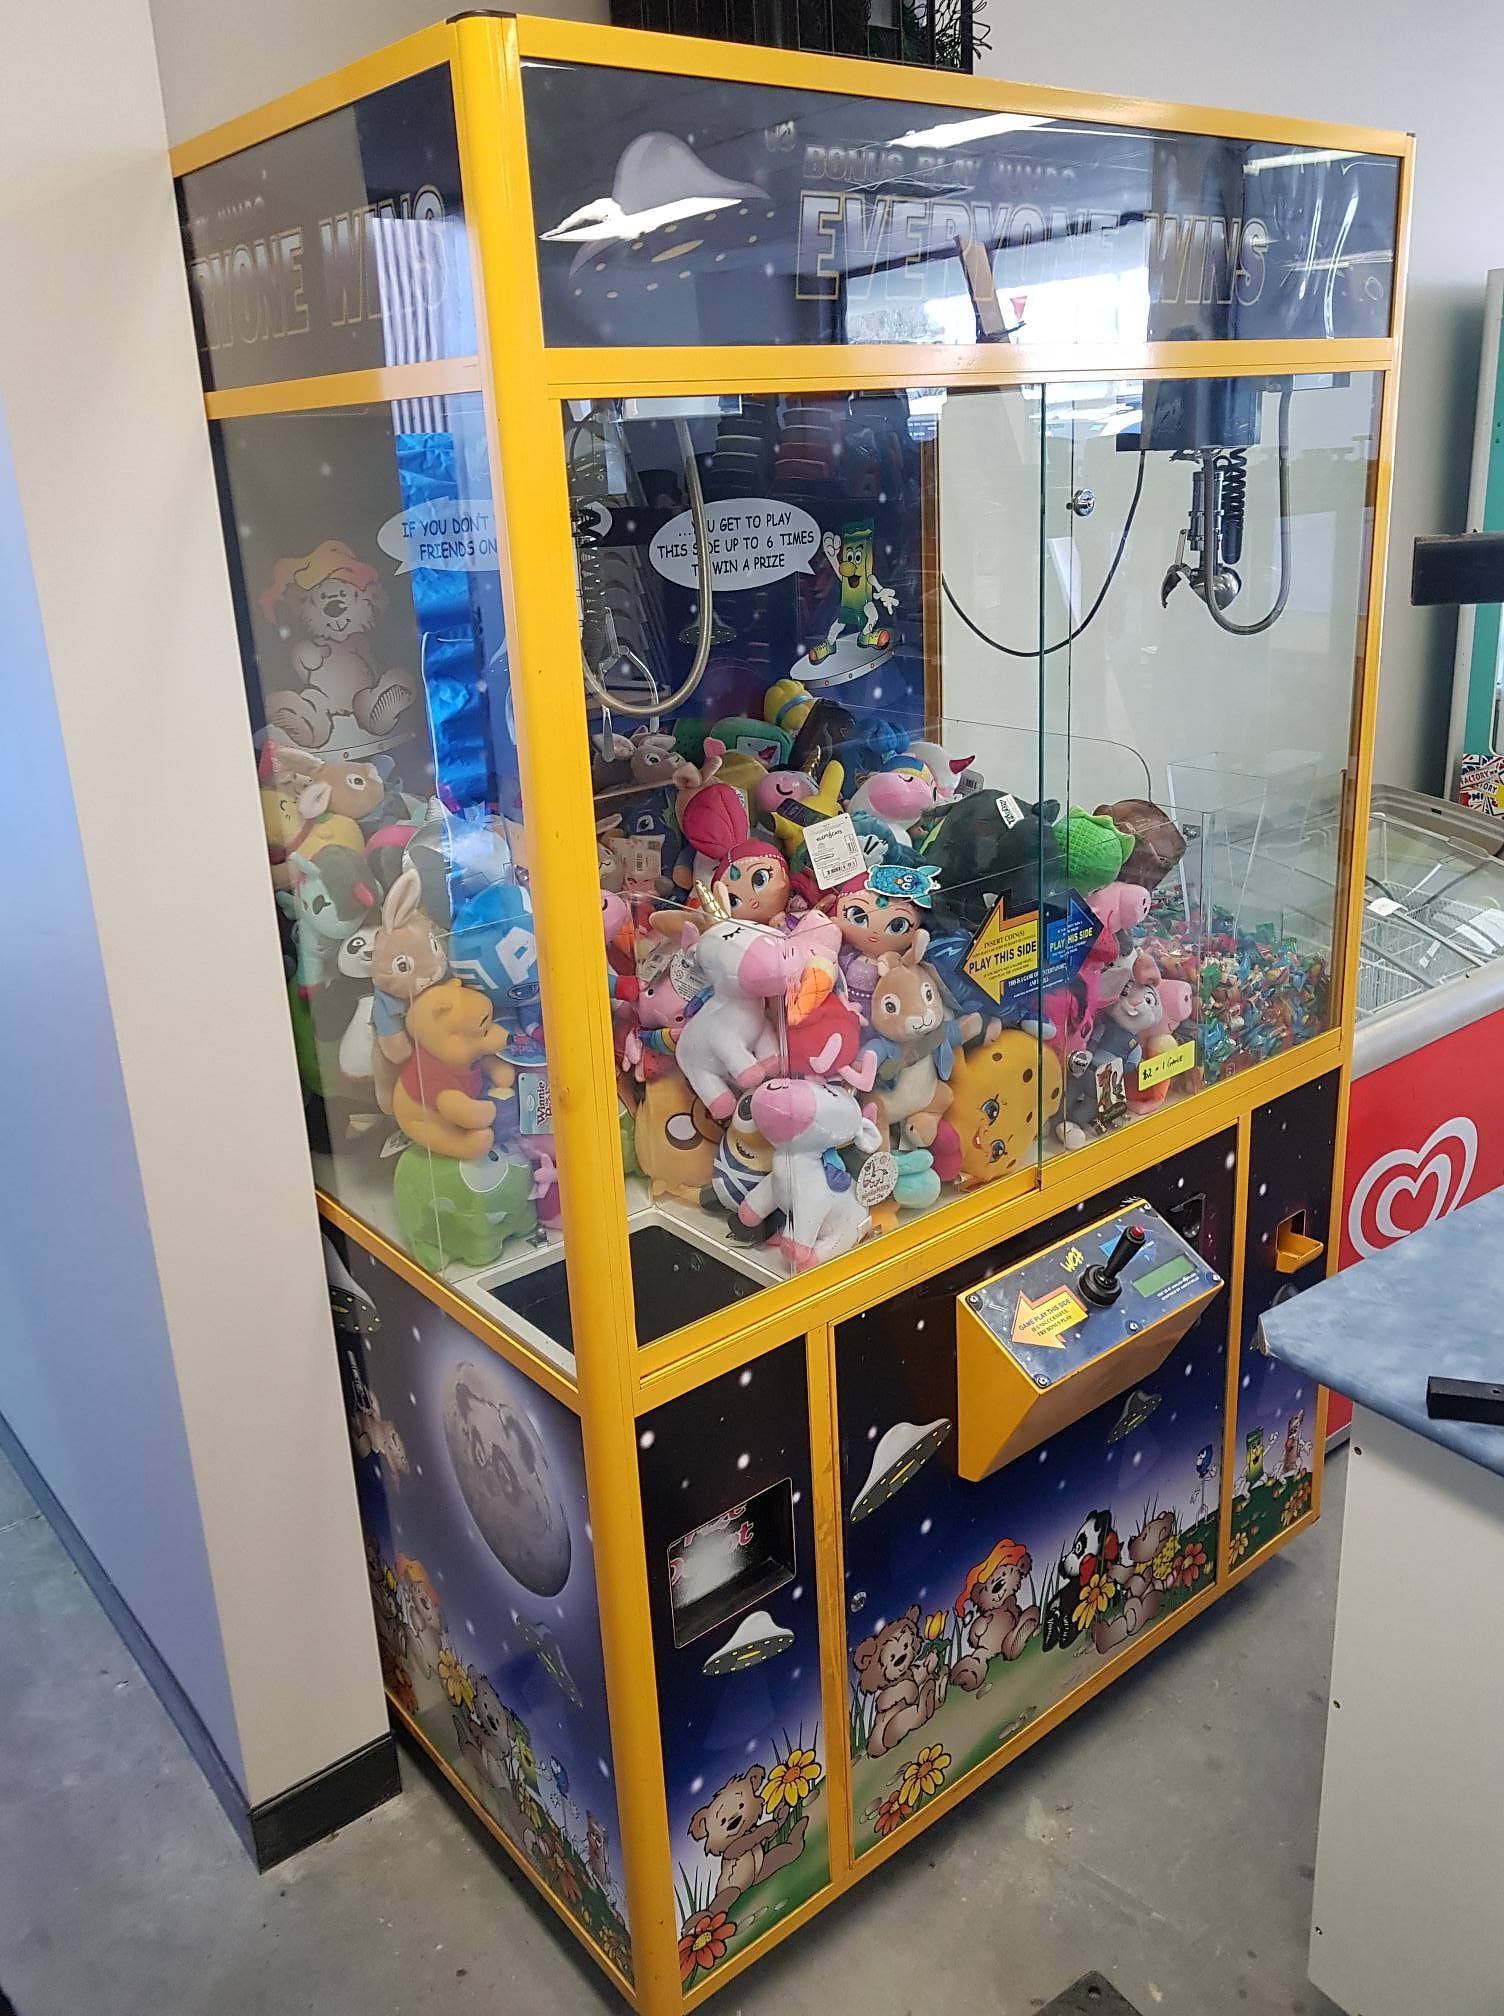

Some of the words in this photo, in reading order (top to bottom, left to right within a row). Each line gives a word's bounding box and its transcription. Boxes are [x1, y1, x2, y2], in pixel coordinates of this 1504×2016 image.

[803, 144, 905, 182] BONUS
[795, 189, 1122, 302] EVERYONE
[1144, 212, 1270, 306] WINS
[401, 521, 416, 538] IF
[420, 519, 447, 537] YOU
[719, 517, 741, 531] GET
[745, 515, 761, 528] TO
[766, 512, 792, 527] PLAY
[419, 541, 475, 560] FRIENDS
[657, 543, 688, 560] THIS
[692, 539, 720, 555] SDE
[725, 537, 739, 552] UP
[743, 536, 759, 550] TO
[766, 536, 774, 549] 6
[779, 531, 814, 546] TIMES
[712, 559, 738, 575] WIN
[743, 558, 751, 571] A
[754, 553, 785, 570] PRIZE
[1050, 938, 1066, 952] PLAY
[1079, 927, 1093, 940] SIDE
[969, 956, 992, 975] PLAY
[994, 948, 1014, 966] THIS
[1017, 941, 1037, 957] SIDE
[537, 1080, 547, 1126] Winnie
[1018, 1318, 1035, 1331] GAME
[1035, 1310, 1047, 1321] PLAY
[1047, 1304, 1059, 1315] THIS
[1058, 1298, 1071, 1309] SIDE
